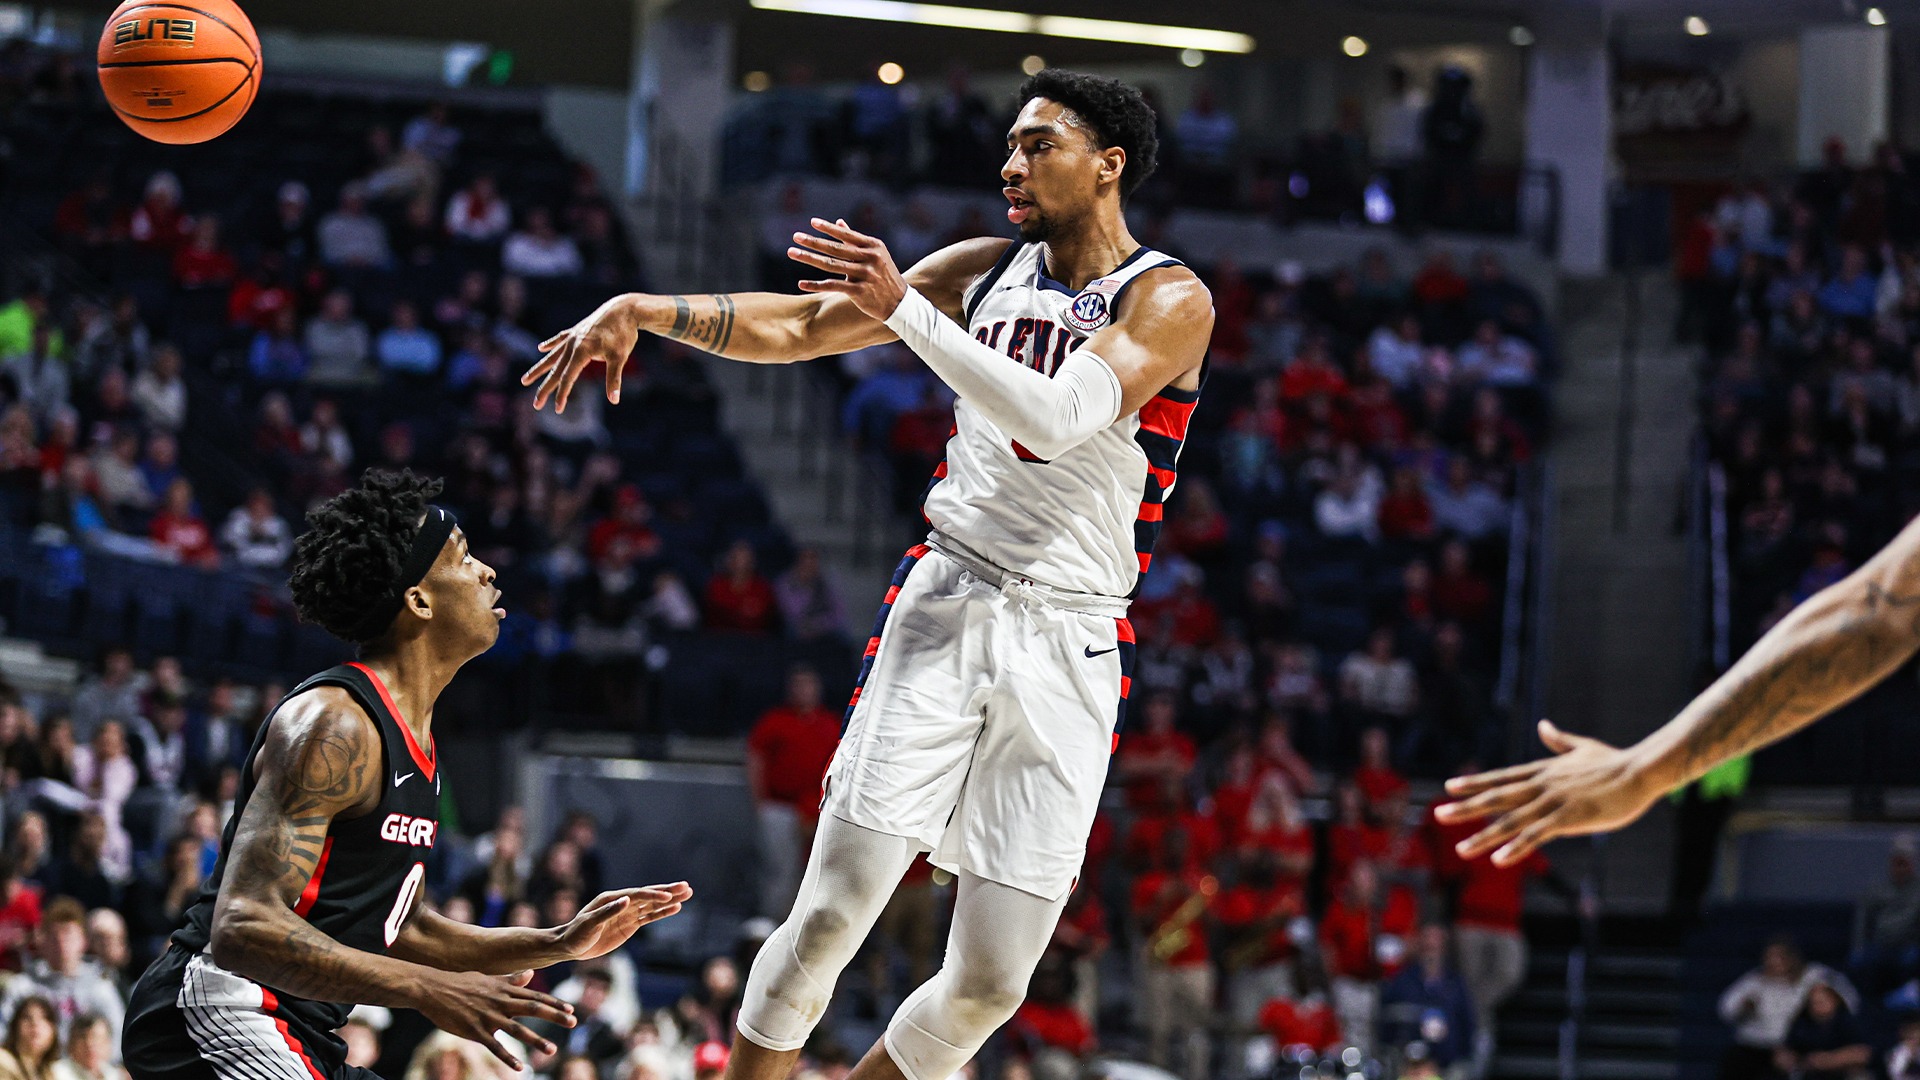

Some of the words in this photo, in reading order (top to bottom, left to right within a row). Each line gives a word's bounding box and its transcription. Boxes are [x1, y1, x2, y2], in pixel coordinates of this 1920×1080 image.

[1075, 294, 1104, 320] SEC
[380, 813, 439, 849] GEOR
[384, 861, 425, 948] 0
